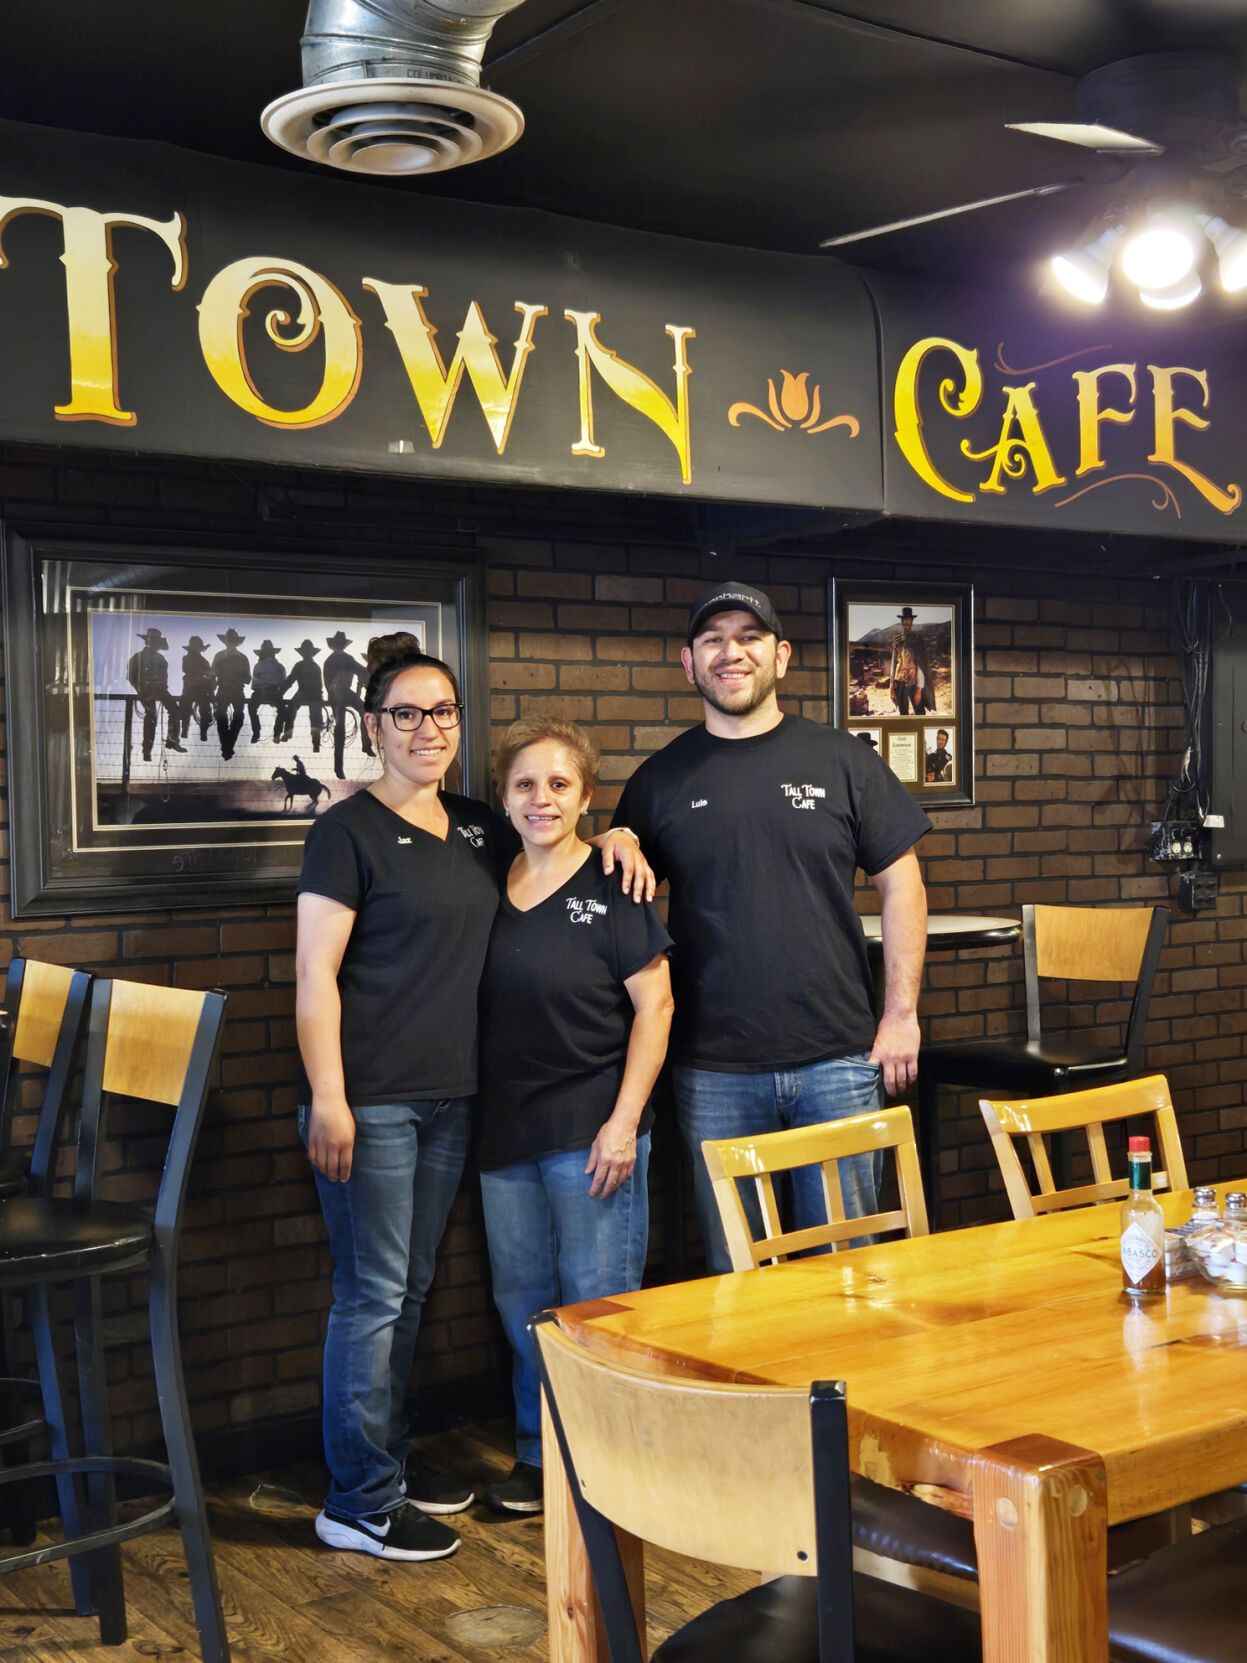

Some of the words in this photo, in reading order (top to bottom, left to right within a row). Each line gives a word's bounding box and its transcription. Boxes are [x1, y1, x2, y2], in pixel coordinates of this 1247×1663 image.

[0, 196, 696, 484] TOWN
[894, 337, 1242, 513] CAFE
[781, 784, 802, 797] TALL
[801, 784, 826, 799] TOWN
[791, 797, 816, 810] CAFE
[565, 896, 584, 911] TALL
[585, 899, 608, 916] TOWN
[570, 910, 594, 925] CAFE
[1122, 1247, 1158, 1258] ABASCO
